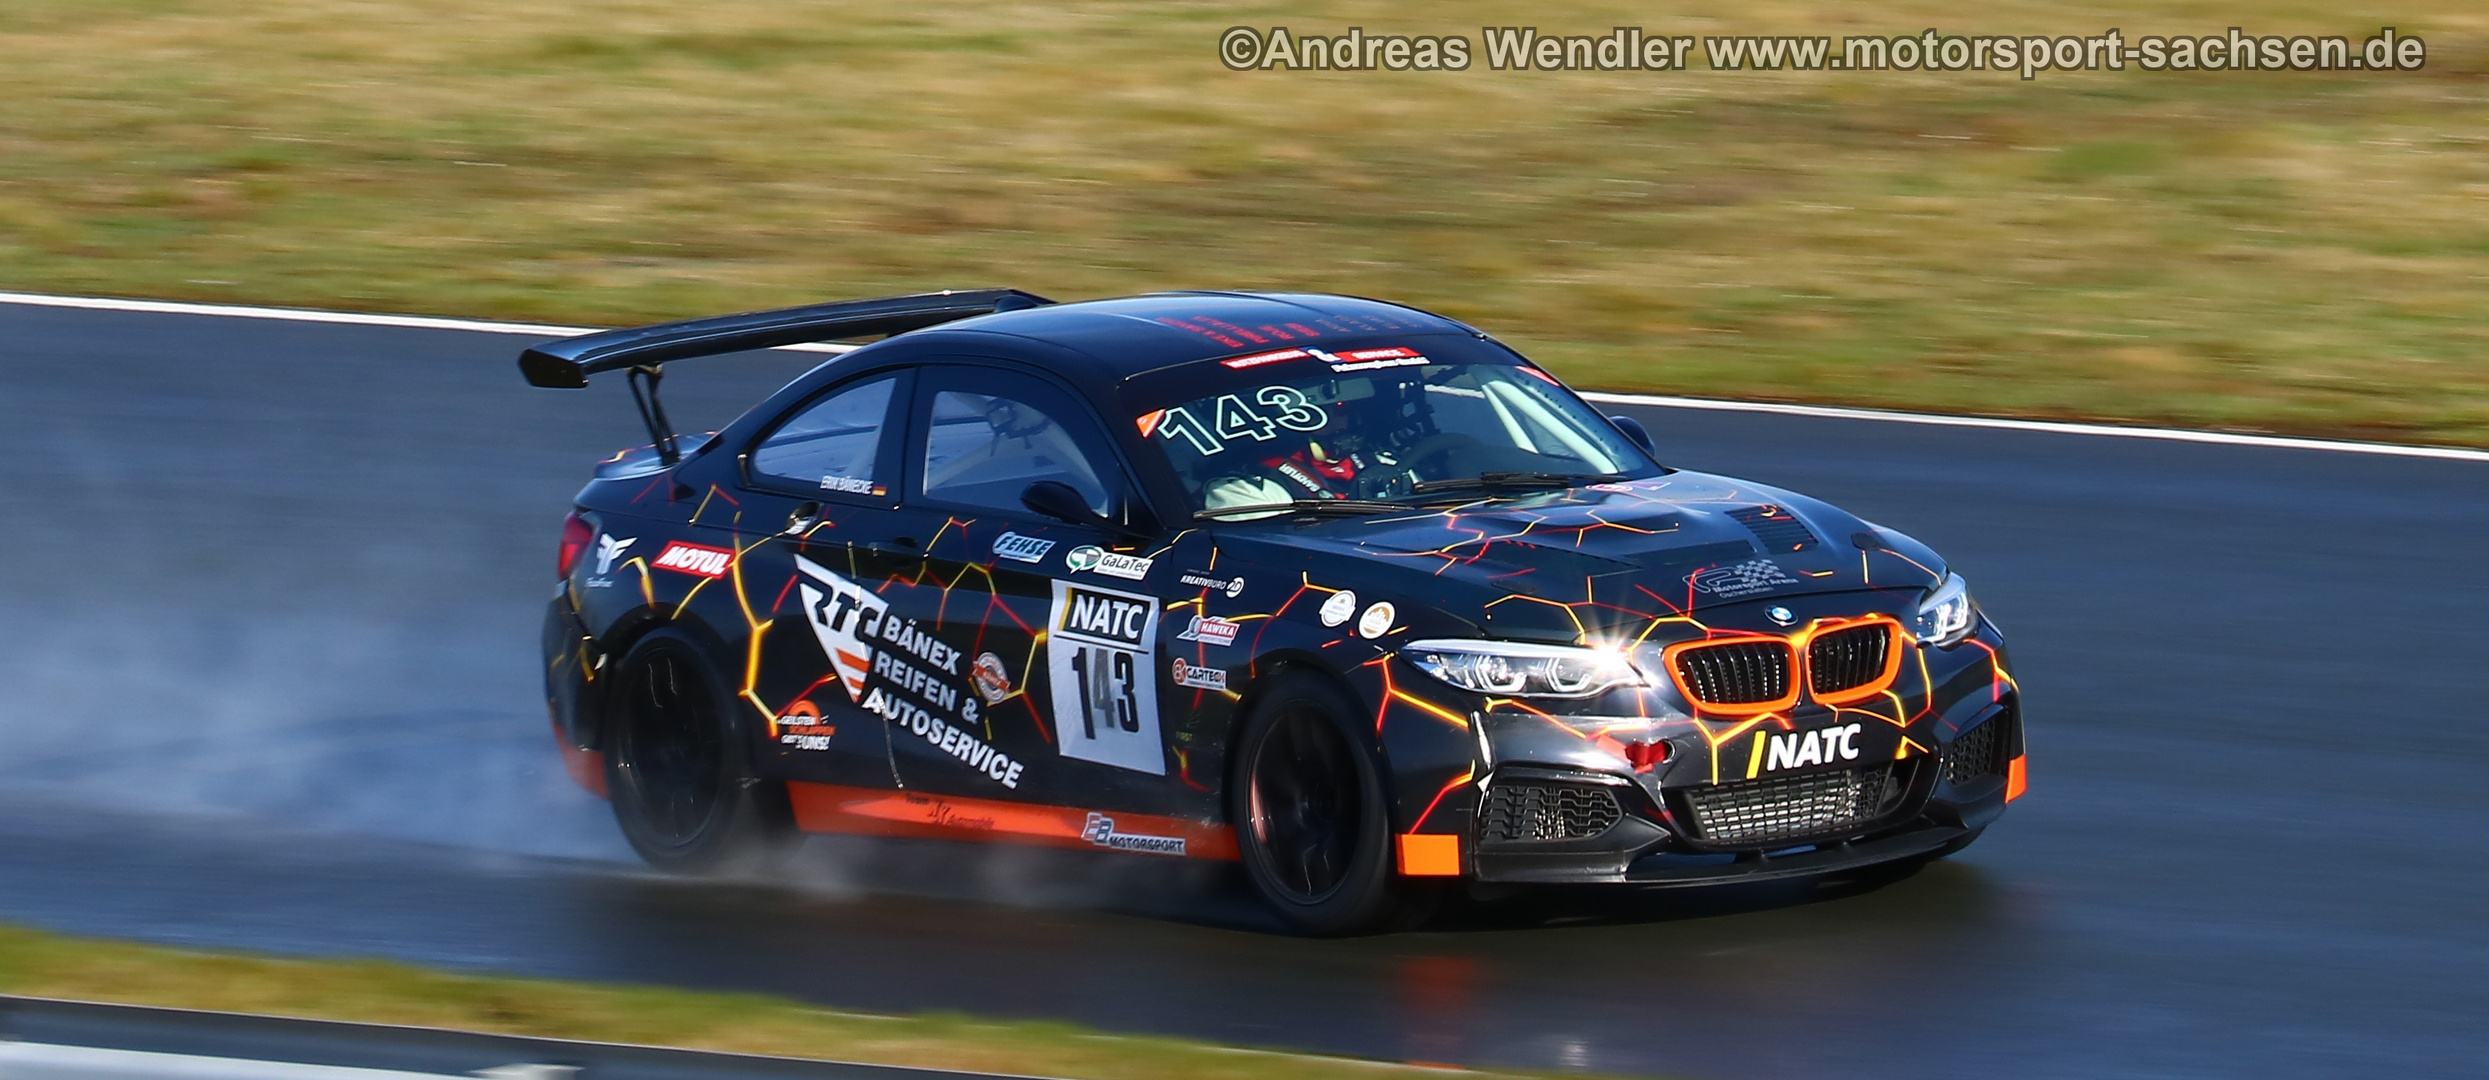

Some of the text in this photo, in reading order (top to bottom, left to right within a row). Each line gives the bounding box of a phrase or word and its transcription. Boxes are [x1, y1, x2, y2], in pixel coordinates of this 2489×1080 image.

[1158, 385, 1328, 456] 143
[656, 546, 730, 575] MOTUL
[995, 535, 1051, 557] FEHSE
[1101, 554, 1149, 573] GaLaTec
[799, 566, 880, 643] RTC
[1712, 580, 1768, 593] Motorsport
[1070, 594, 1144, 640] NATC
[1200, 621, 1236, 637] HAWEKA
[883, 614, 962, 677] BÄNEX
[874, 650, 958, 713] REIFEN
[961, 697, 980, 725] &
[1072, 647, 1140, 741] 143
[862, 686, 1025, 790] AUTOSERVICE
[1766, 723, 1862, 772] NATC
[1109, 836, 1184, 854] MOTORSPORT
